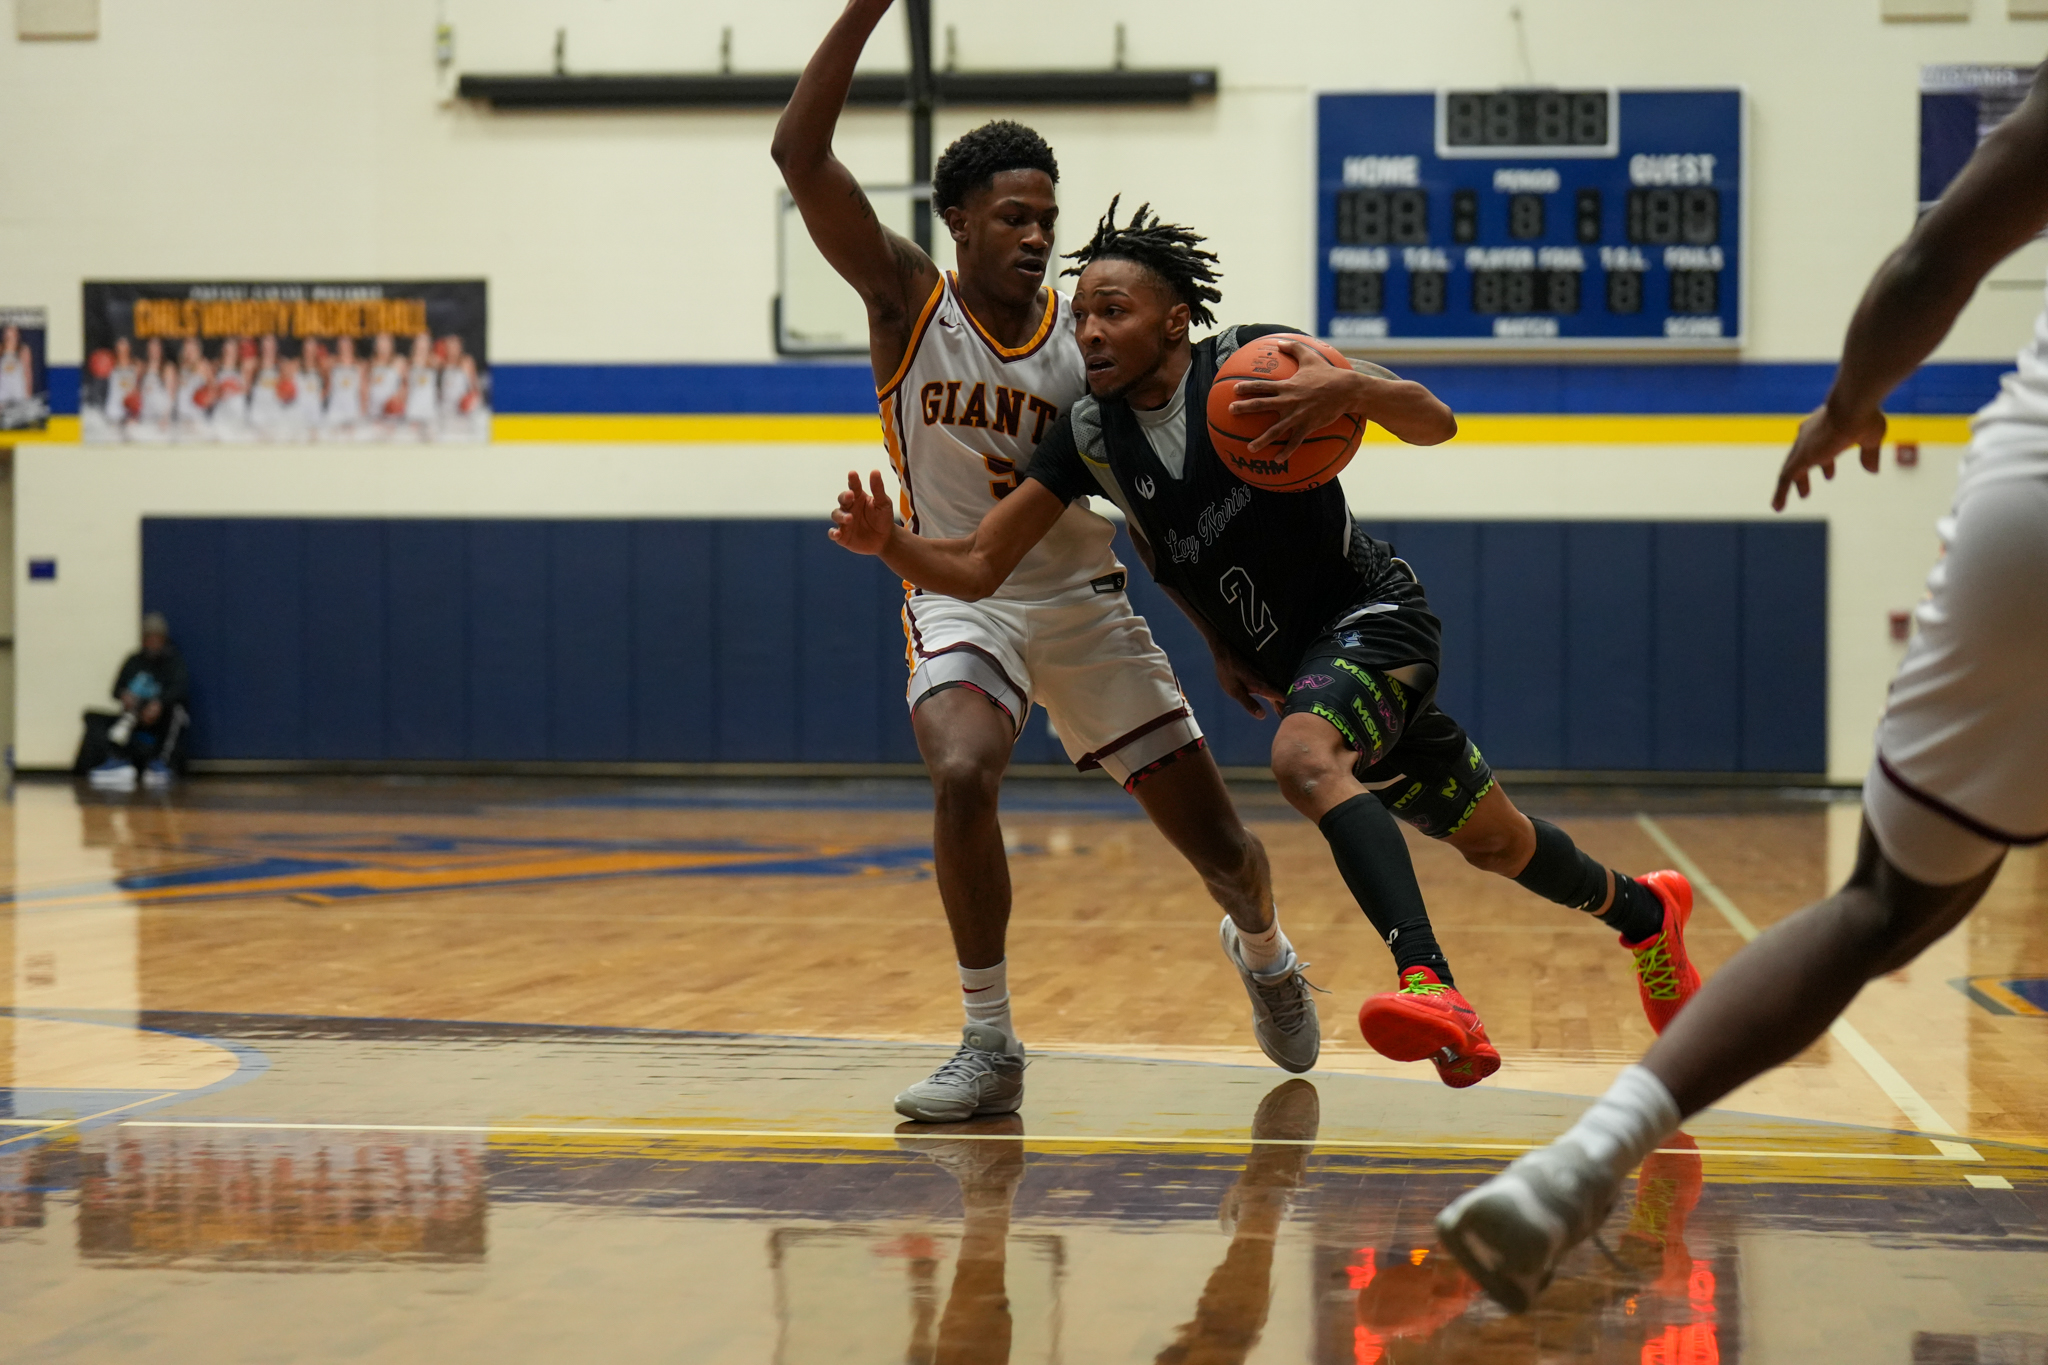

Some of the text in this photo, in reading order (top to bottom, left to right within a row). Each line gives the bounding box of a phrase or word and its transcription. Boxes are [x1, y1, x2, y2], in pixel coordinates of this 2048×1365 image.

[1343, 155, 1420, 187] HOME
[1630, 153, 1717, 186] GUEST
[1164, 484, 1251, 564] Loy Norrix
[1220, 566, 1279, 652] 2
